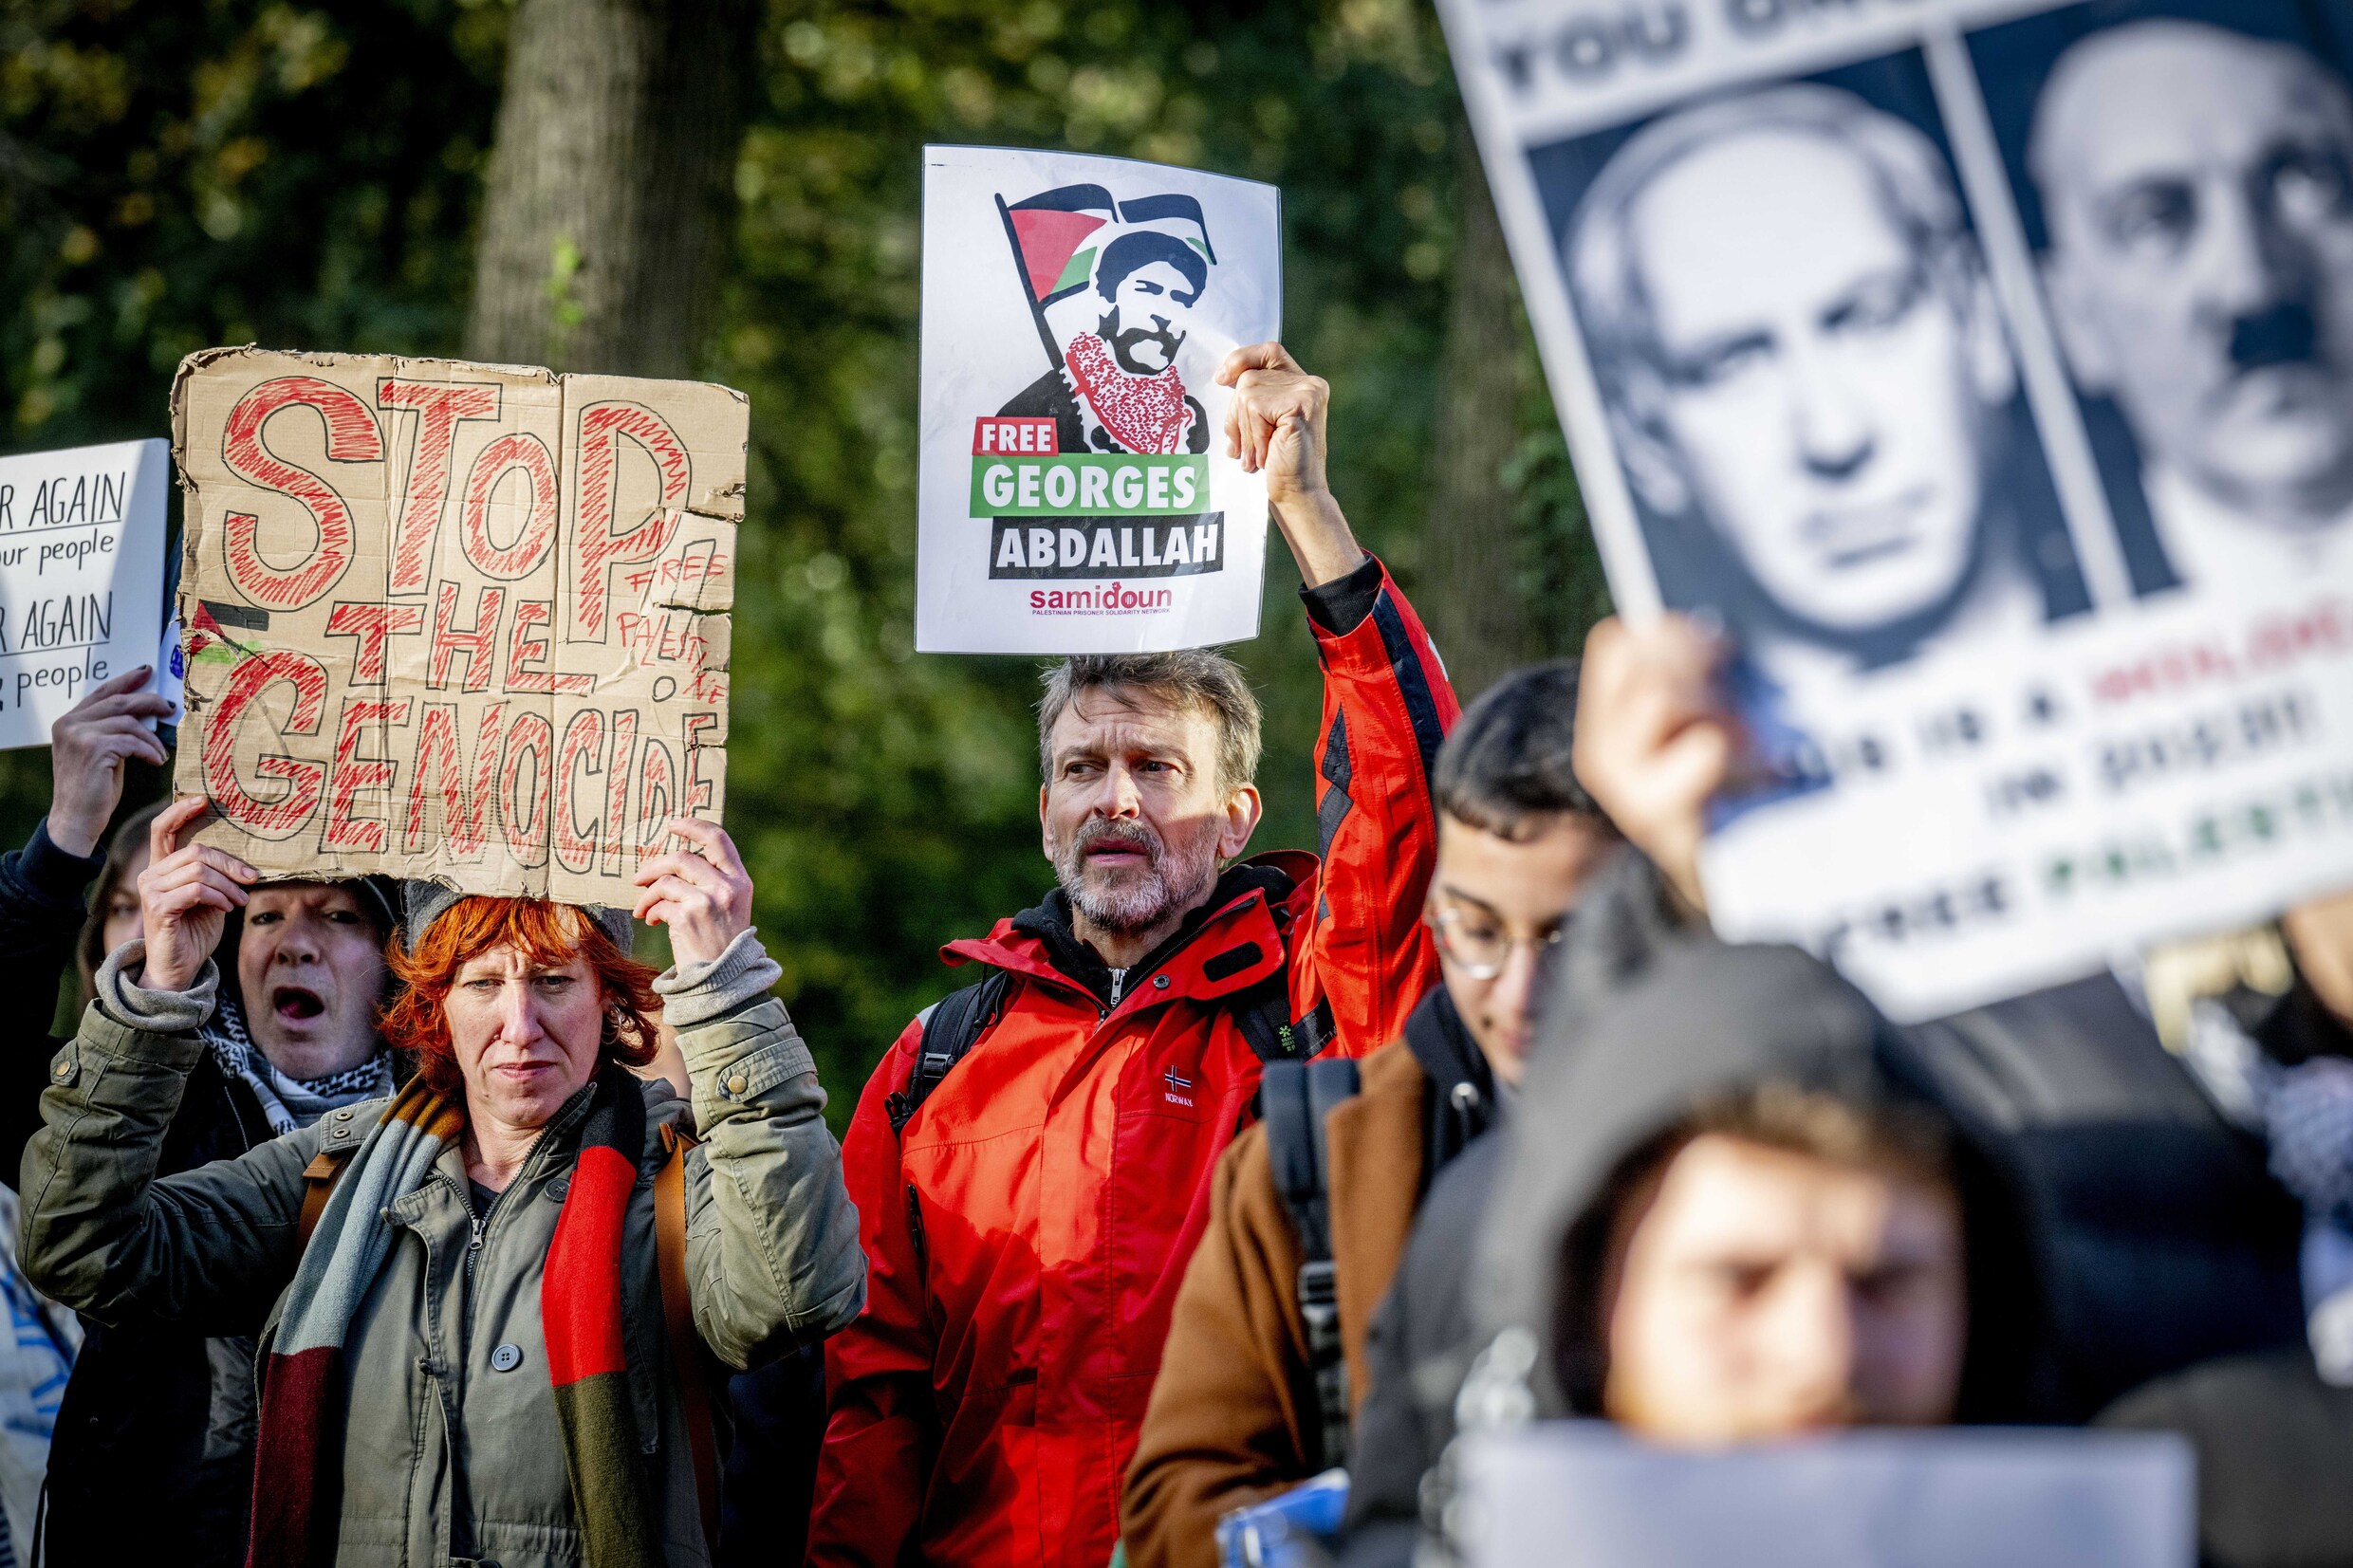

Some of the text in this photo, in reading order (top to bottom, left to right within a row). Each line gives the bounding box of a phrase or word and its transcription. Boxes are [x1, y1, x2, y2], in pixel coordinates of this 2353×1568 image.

[981, 423, 1052, 452] FREE
[28, 471, 126, 528] AGAIN
[222, 375, 693, 644] STOP
[982, 464, 1196, 509] GEORGES
[39, 527, 115, 576] people
[995, 523, 1219, 568] ABDALLAH
[624, 555, 730, 593] FREE
[1029, 581, 1173, 609] samidoun
[21, 590, 113, 651] AGAIN
[324, 580, 597, 697] THE
[17, 646, 110, 708] people
[201, 648, 719, 877] GENOCIDE
[1164, 1092, 1194, 1107] NORWAY
